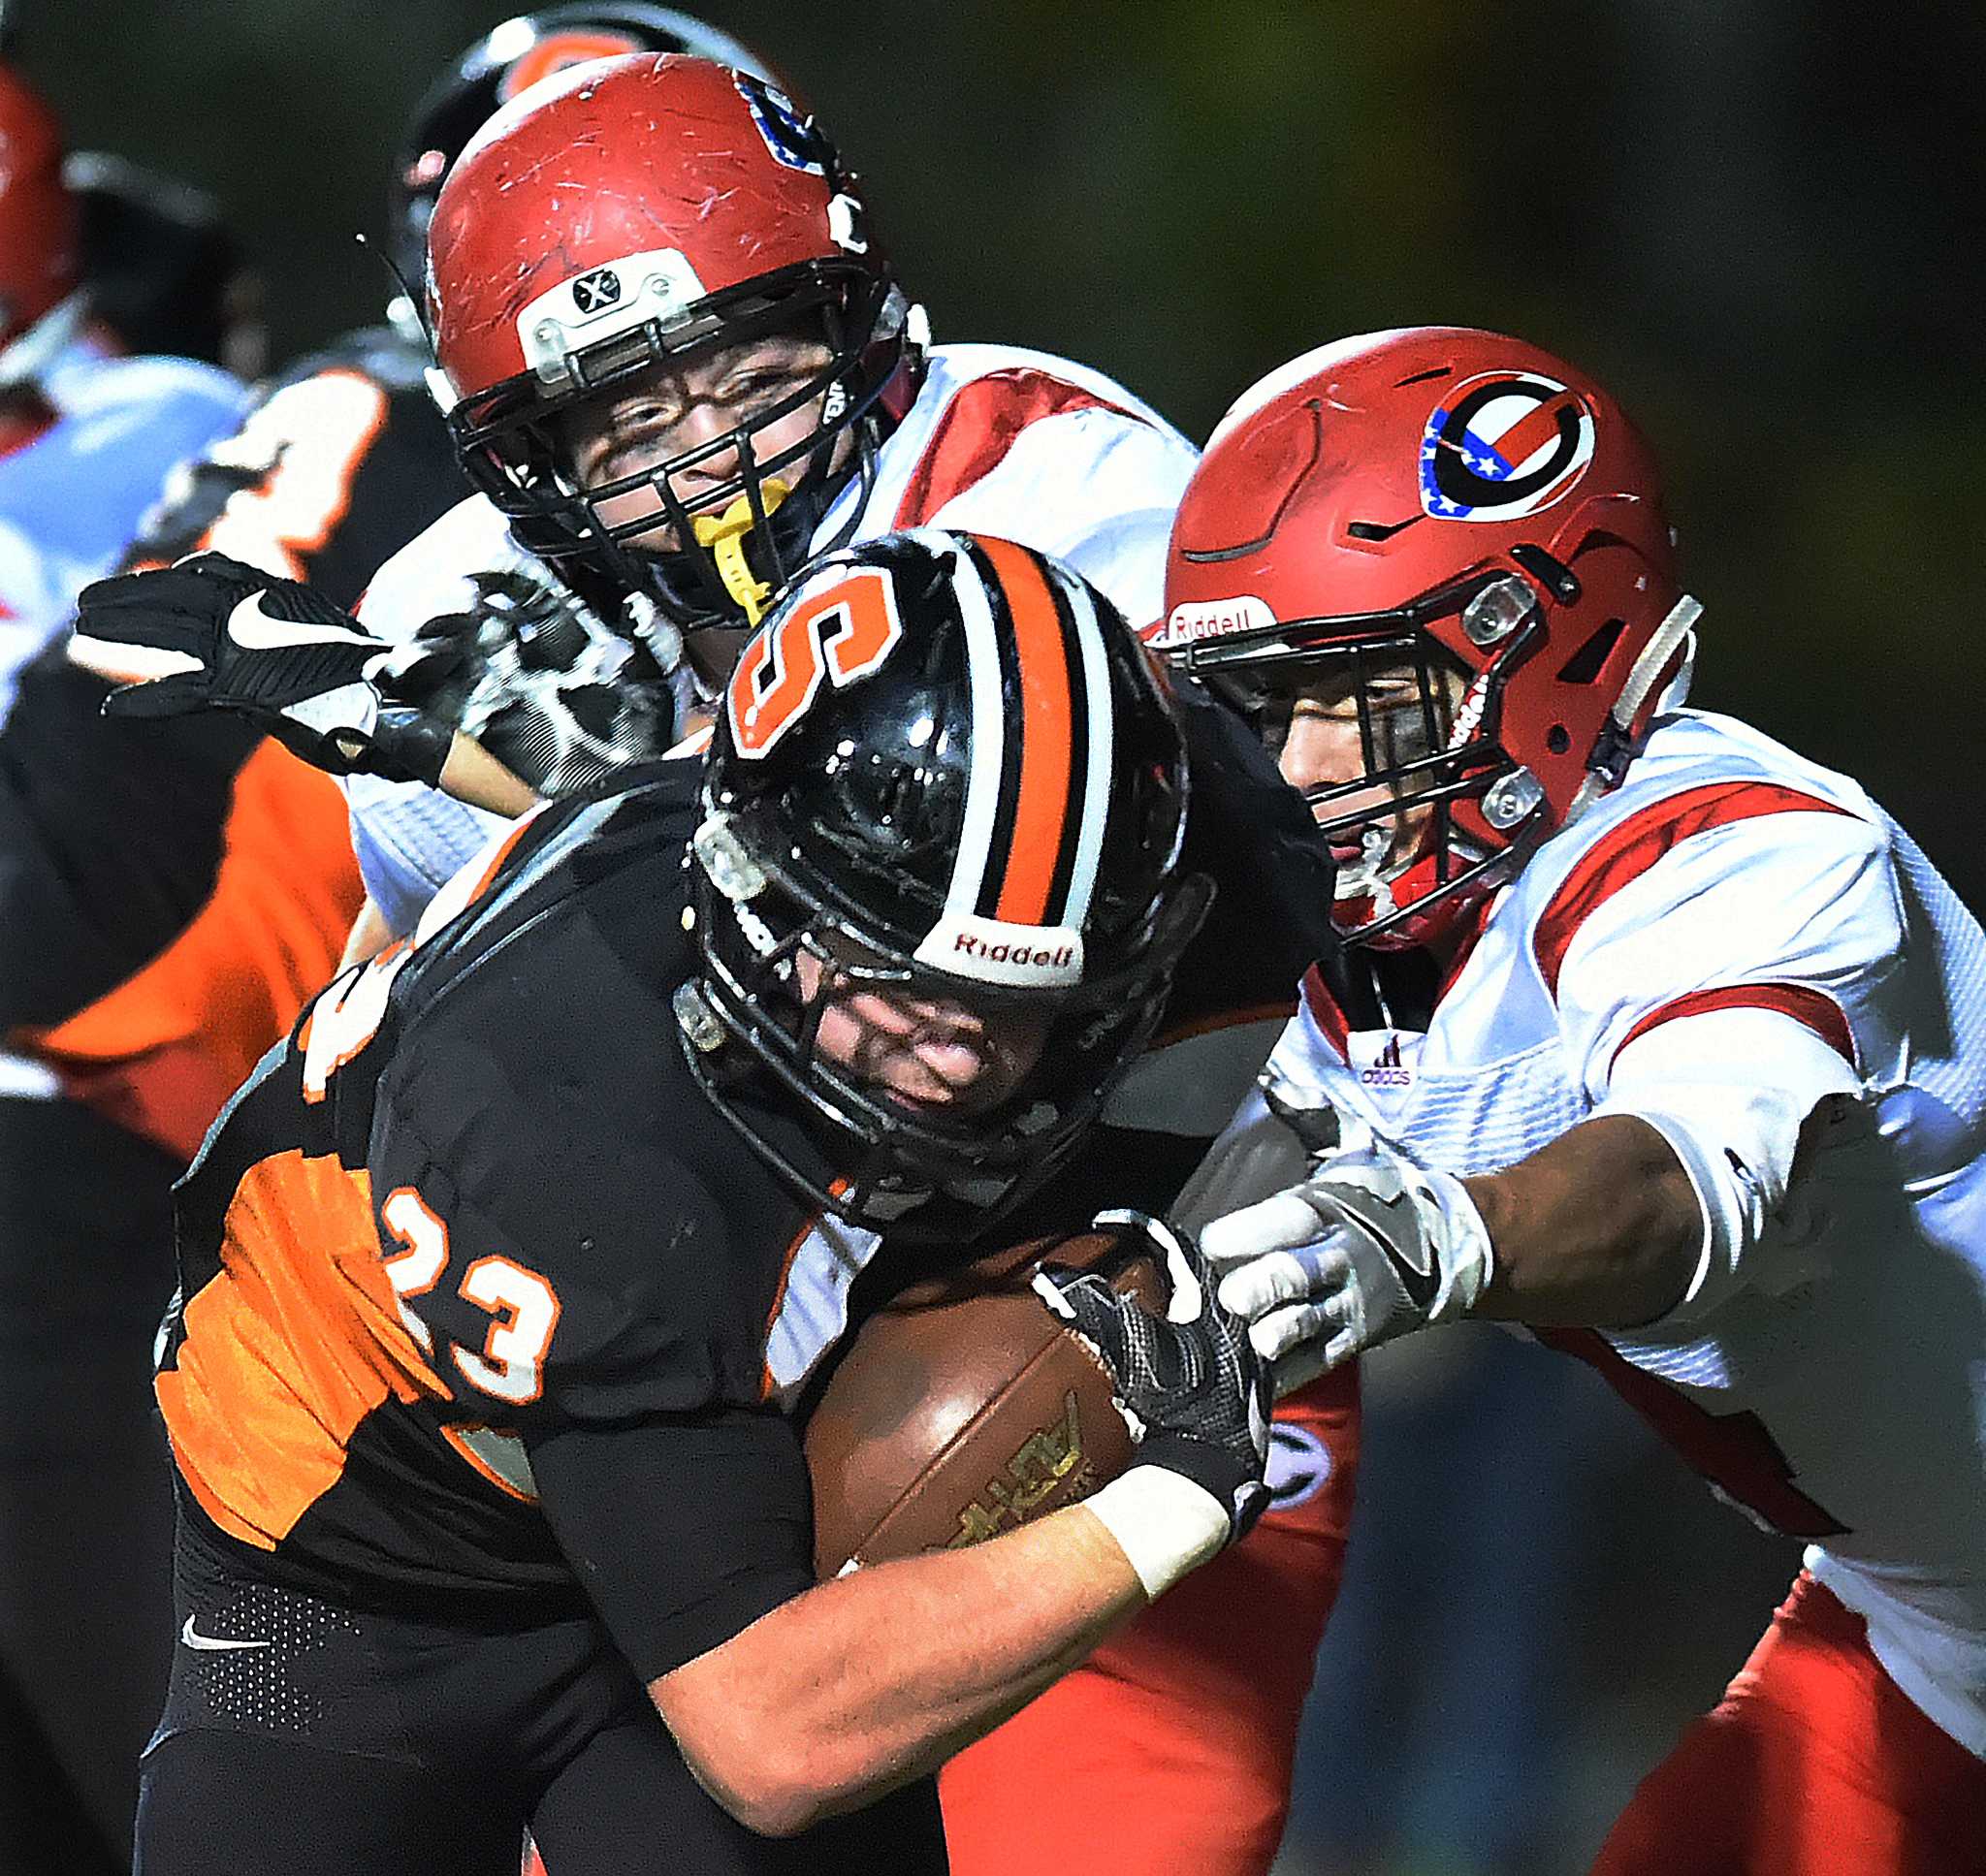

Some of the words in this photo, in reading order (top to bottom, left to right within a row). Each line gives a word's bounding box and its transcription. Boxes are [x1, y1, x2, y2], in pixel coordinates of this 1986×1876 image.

[728, 564, 903, 760] S
[1175, 608, 1250, 640] Riddell
[954, 933, 1073, 968] Riddell
[381, 1185, 562, 1406] 23
